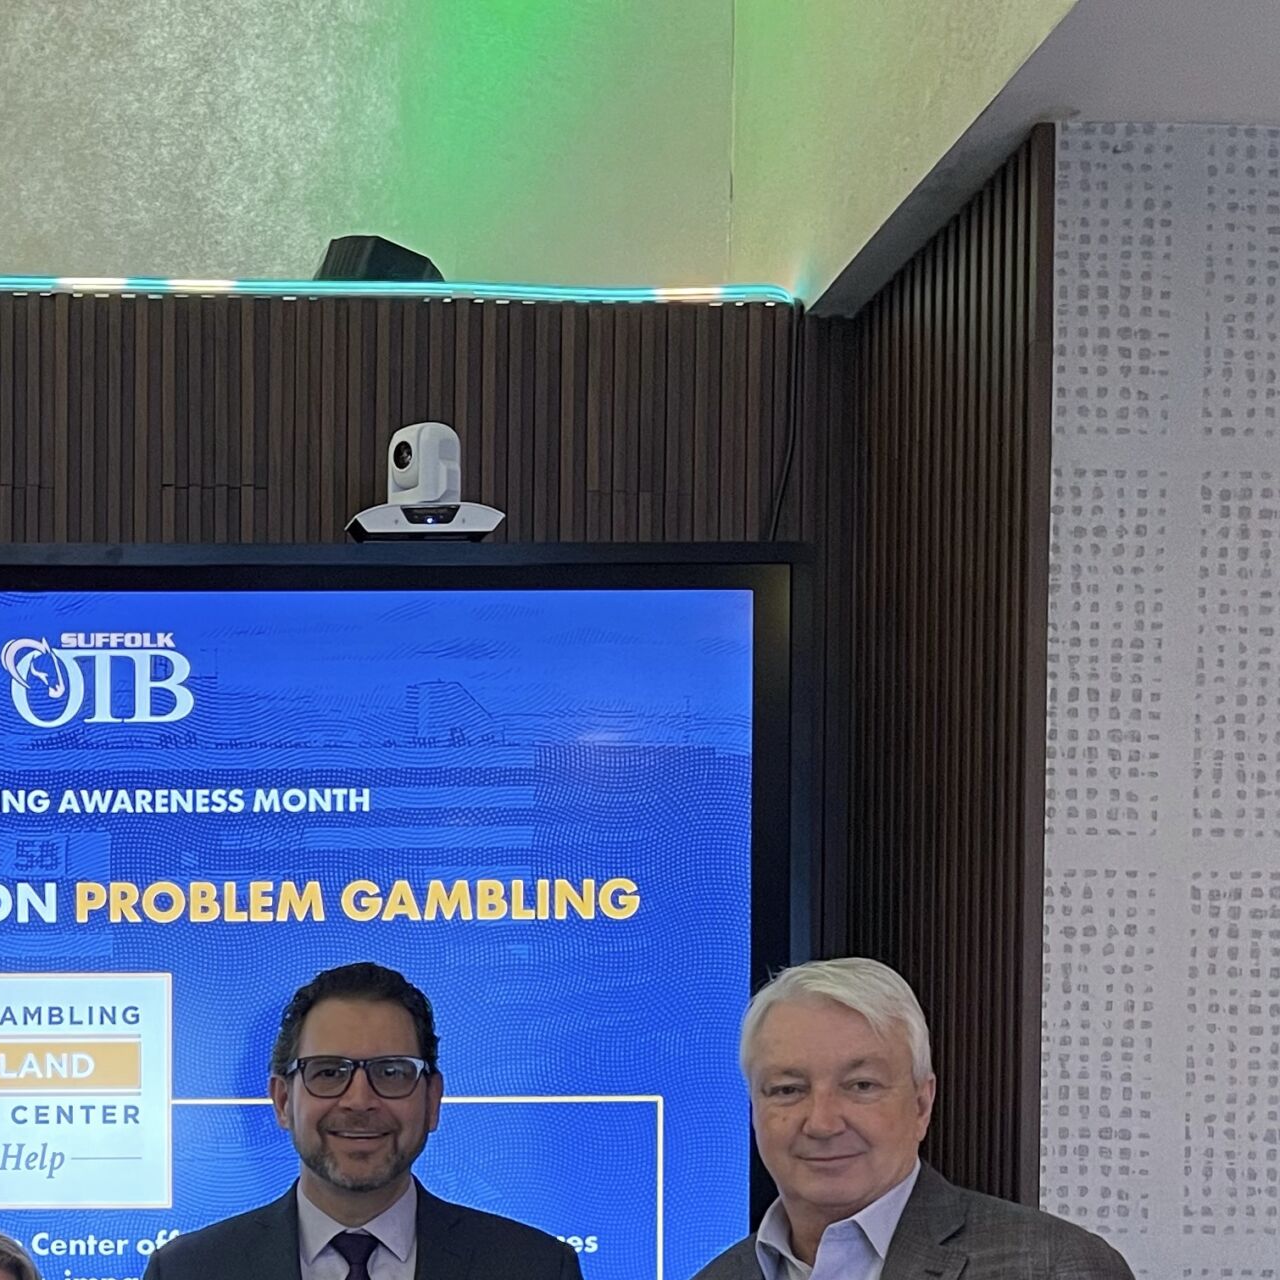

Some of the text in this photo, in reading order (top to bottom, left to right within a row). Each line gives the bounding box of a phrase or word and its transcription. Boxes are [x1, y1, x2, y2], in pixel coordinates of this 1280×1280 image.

[60, 632, 176, 649] SUFFOLK
[10, 648, 195, 729] OTB
[58, 788, 245, 814] AWARENESS
[253, 788, 371, 813] MONTH
[74, 880, 326, 923] PROBLEM
[342, 877, 641, 922] GAMBLING
[11, 1105, 141, 1125] CENTER
[31, 1232, 130, 1256] Center
